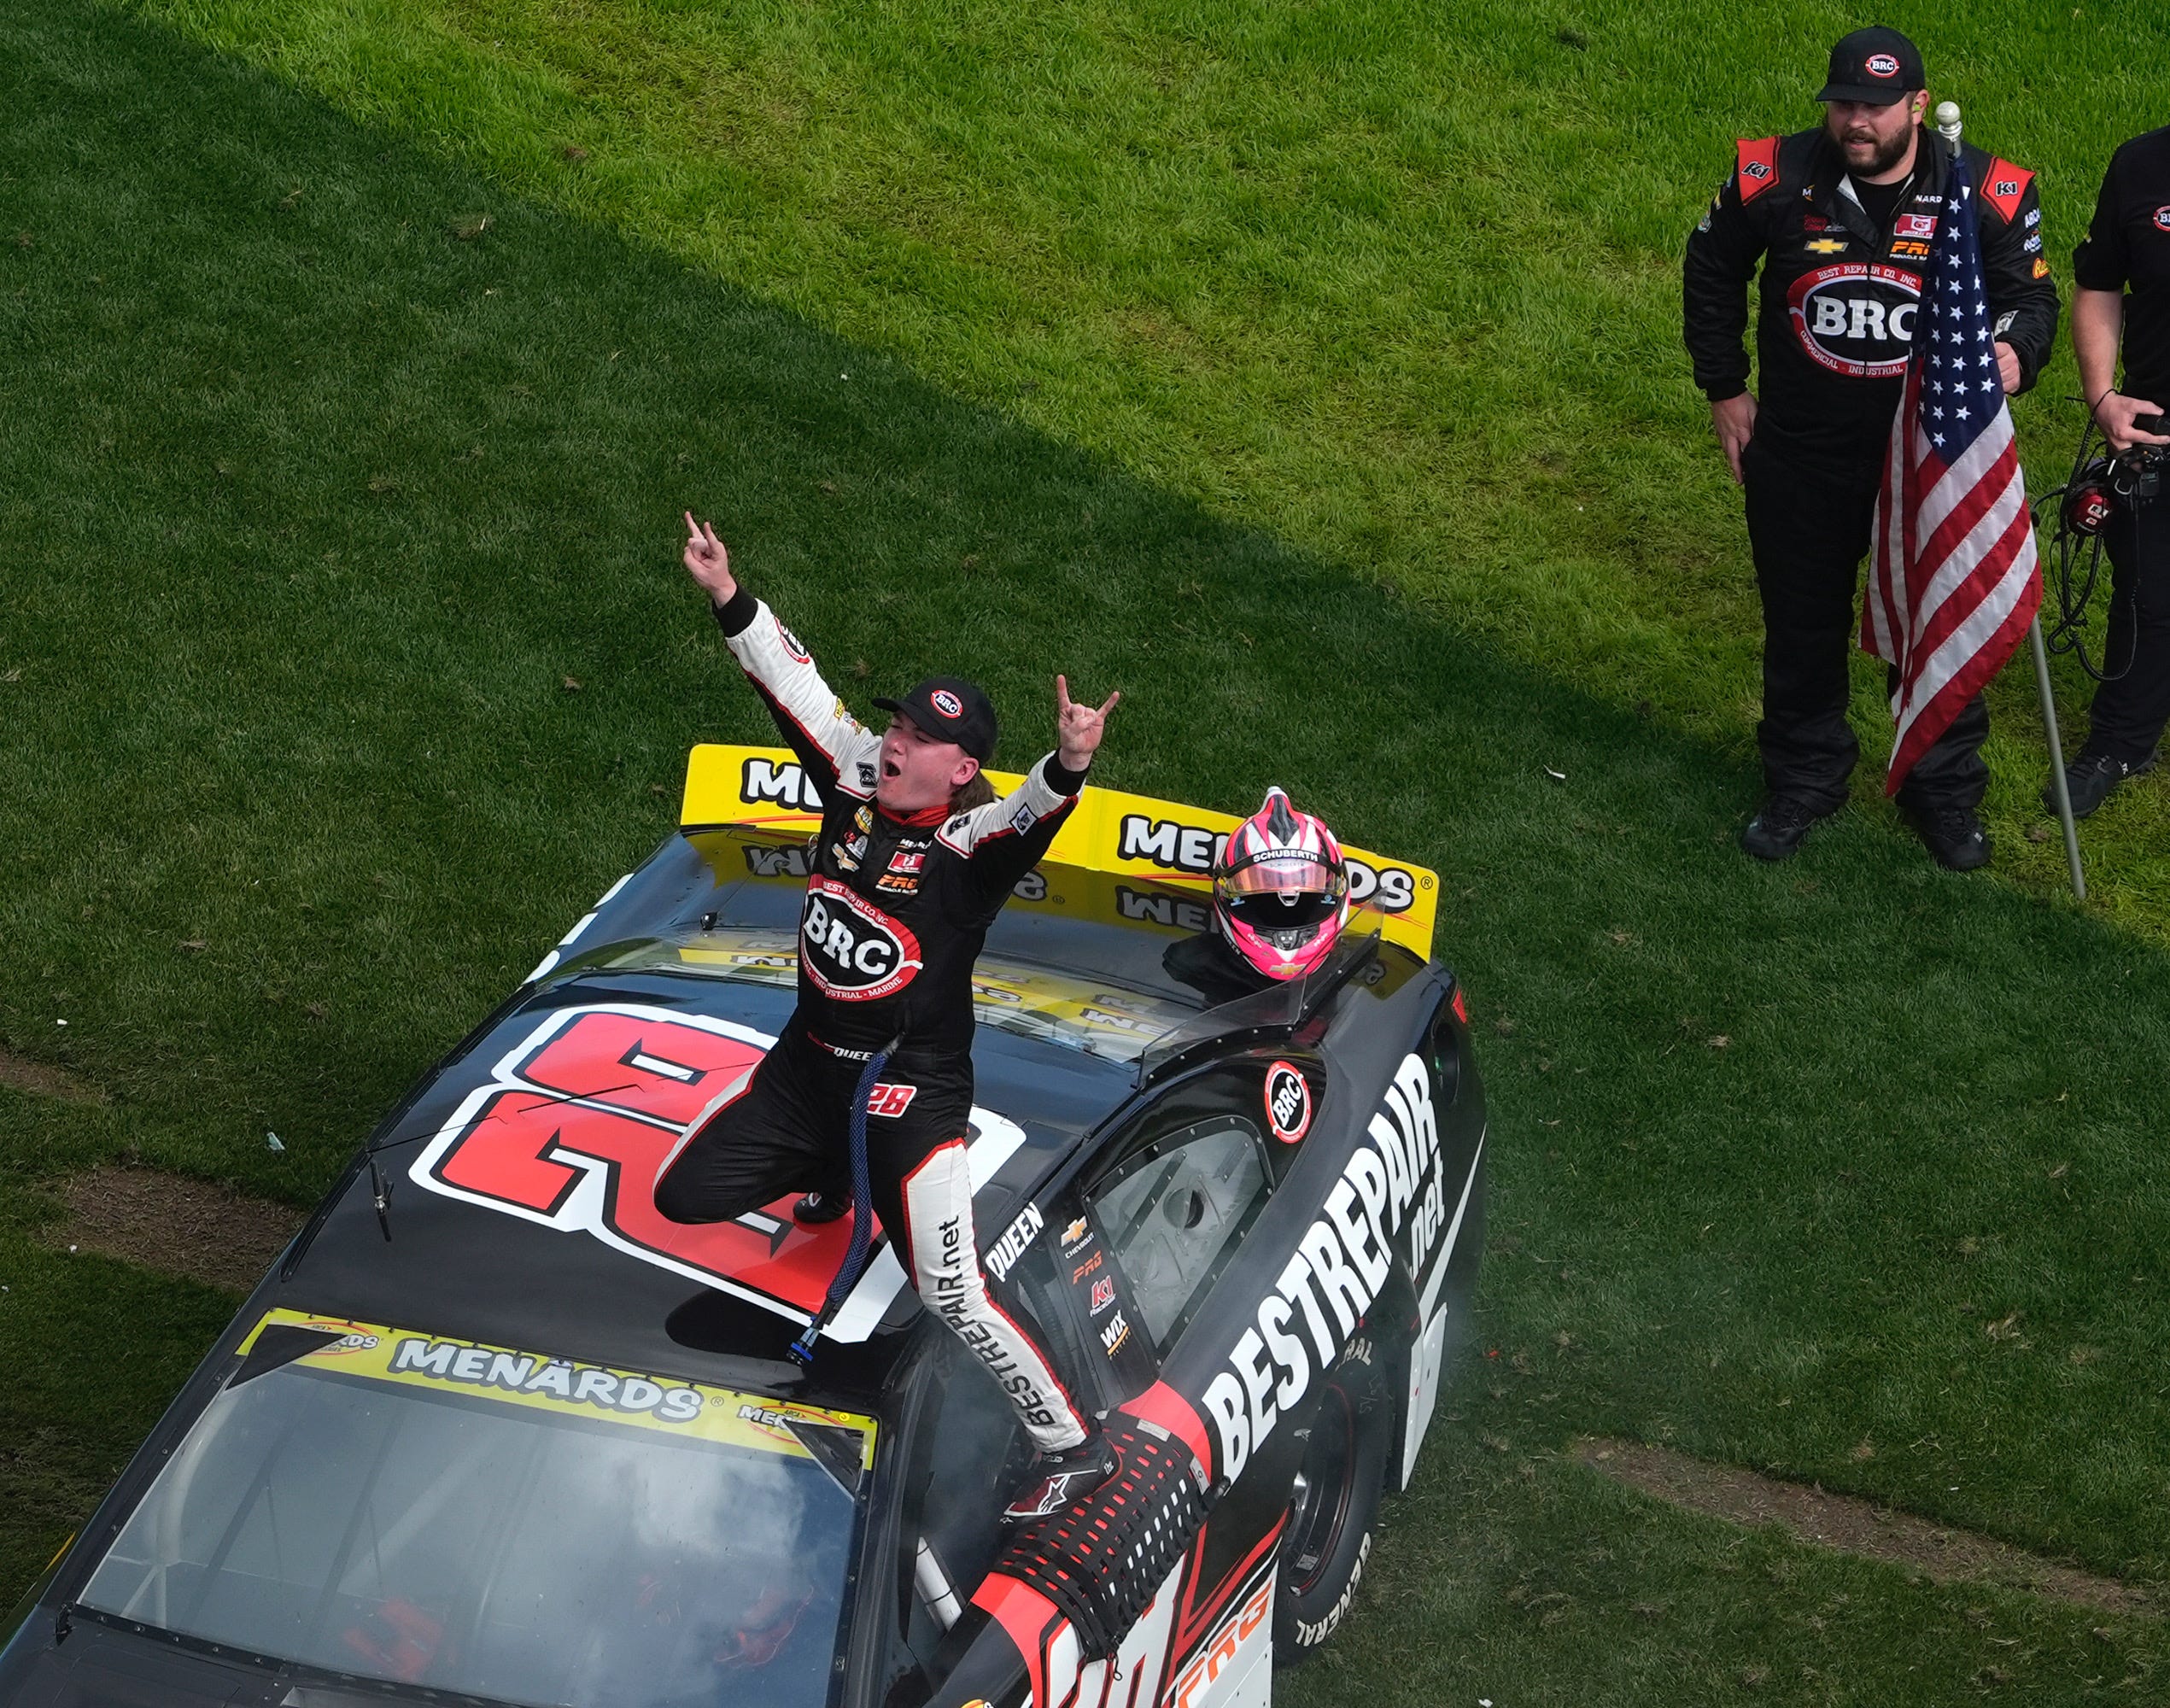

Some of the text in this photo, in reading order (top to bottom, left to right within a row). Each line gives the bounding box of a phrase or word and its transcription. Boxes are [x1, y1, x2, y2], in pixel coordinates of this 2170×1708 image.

[1872, 60, 1894, 71] BRC
[1741, 161, 1771, 179] K1
[1995, 180, 2018, 197] K1
[1817, 267, 1840, 281] BEST
[1844, 265, 1880, 276] REPAIR
[1884, 268, 1897, 280] CO.
[1811, 295, 1920, 342] BRC
[1800, 330, 1840, 370] COMMERCIAL
[1848, 365, 1904, 377] INDUSTRIAL
[935, 694, 958, 714] BRC
[1119, 815, 1414, 912] MEDS
[1253, 850, 1319, 863] SCHUBERTH
[878, 874, 919, 890] PRG
[804, 897, 892, 975] BRC
[814, 976, 903, 999] INDUSTRIAL MARINE
[834, 1047, 874, 1062] QUEE
[866, 1083, 917, 1118] 28
[1273, 1075, 1302, 1128] BRC
[1409, 1146, 1446, 1283] .net
[985, 1201, 1044, 1283] QUEEN
[1064, 1231, 1095, 1259] CHEVROLET
[1073, 1250, 1103, 1284] PRG
[1202, 1053, 1438, 1489] BESTREPAIR
[1091, 1275, 1114, 1308] K1
[1100, 1309, 1127, 1348] WIX
[391, 1338, 704, 1421] MENARDS
[1295, 1531, 1372, 1647] GENERAL
